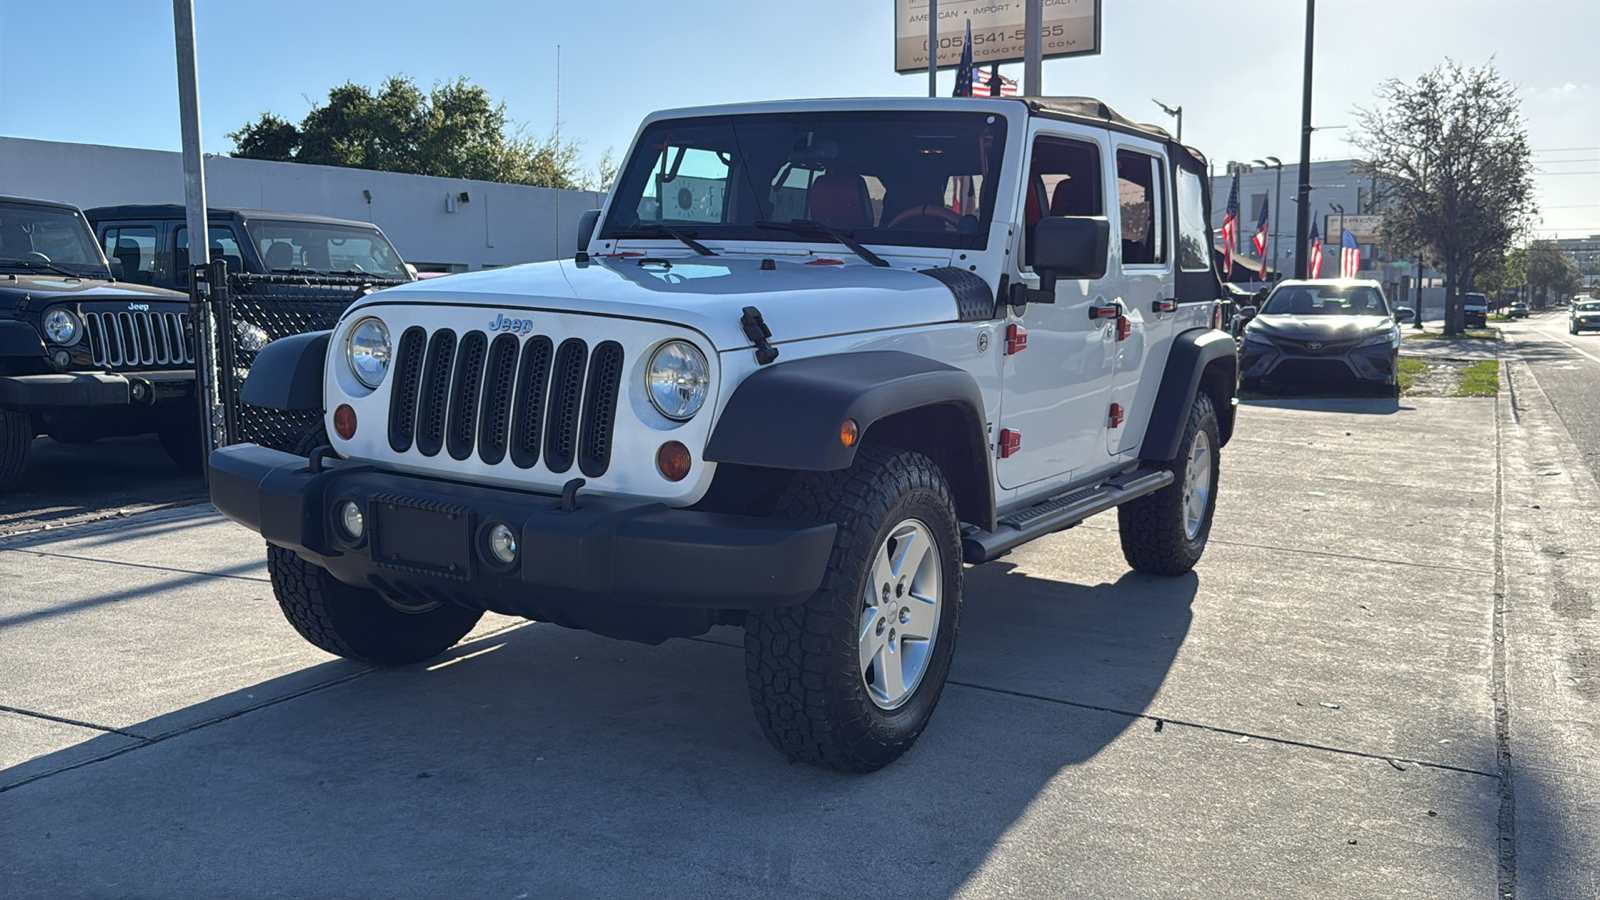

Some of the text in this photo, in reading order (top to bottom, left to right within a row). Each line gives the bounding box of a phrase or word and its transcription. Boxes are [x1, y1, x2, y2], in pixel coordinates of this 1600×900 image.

[909, 10, 958, 22] AMECAN
[972, 4, 1010, 15] IMPORT
[923, 25, 1064, 51] (05 541-555
[128, 302, 149, 311] Jeep
[489, 313, 533, 336] Jeep
